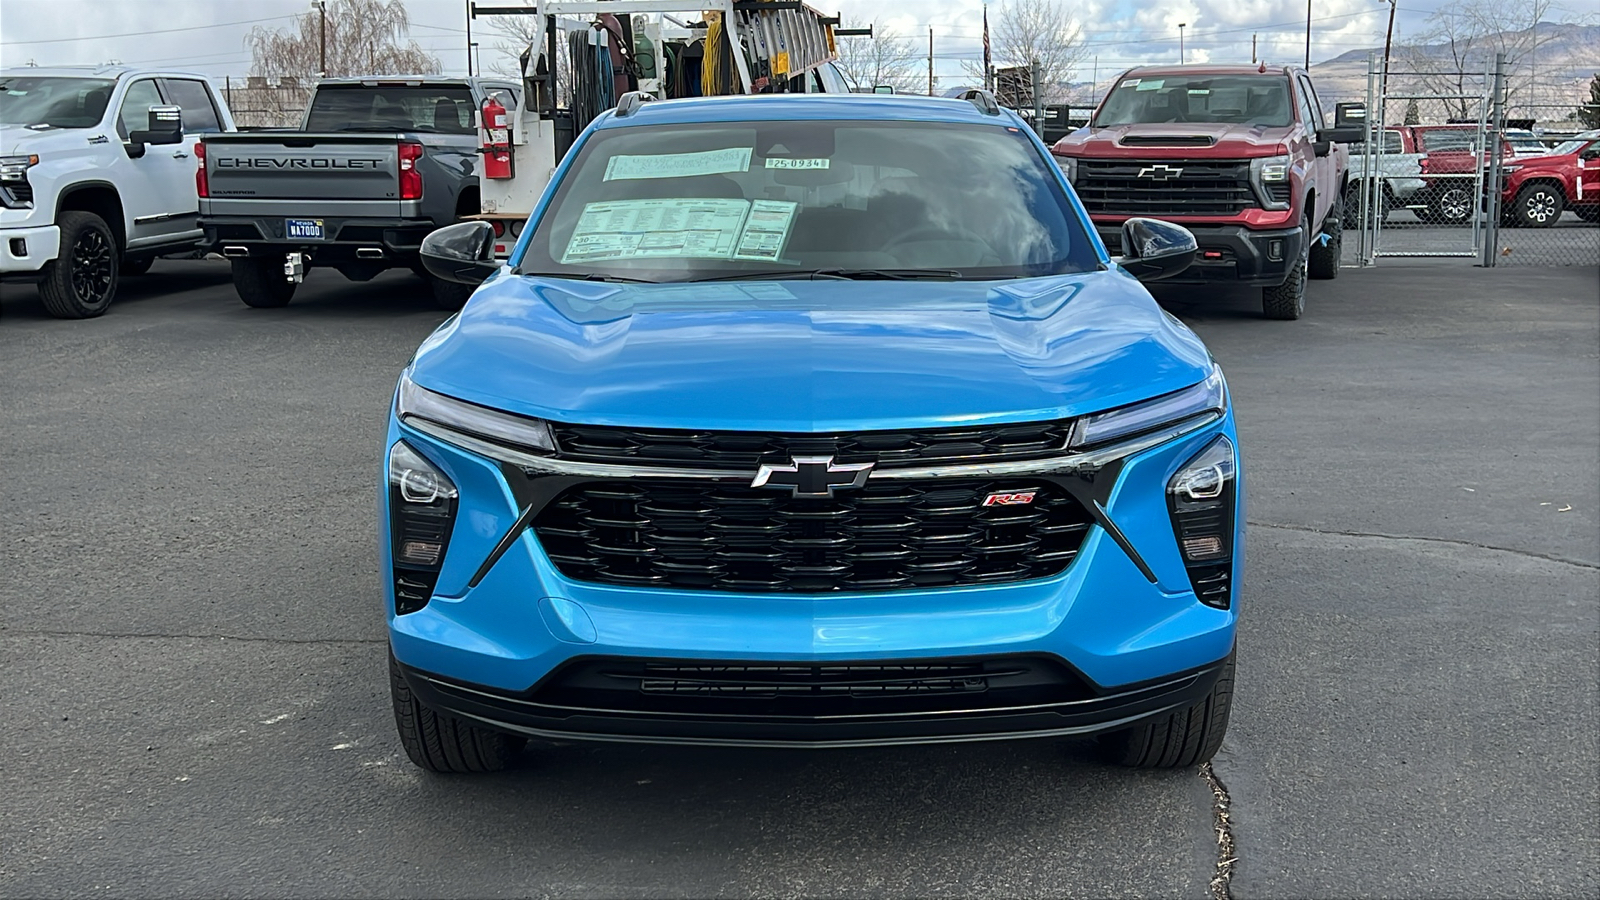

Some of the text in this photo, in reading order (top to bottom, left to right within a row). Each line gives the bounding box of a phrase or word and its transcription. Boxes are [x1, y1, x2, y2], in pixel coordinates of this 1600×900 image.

[218, 158, 383, 169] CHEVROLET
[774, 159, 819, 168] 25-0934
[982, 492, 1036, 506] RS
